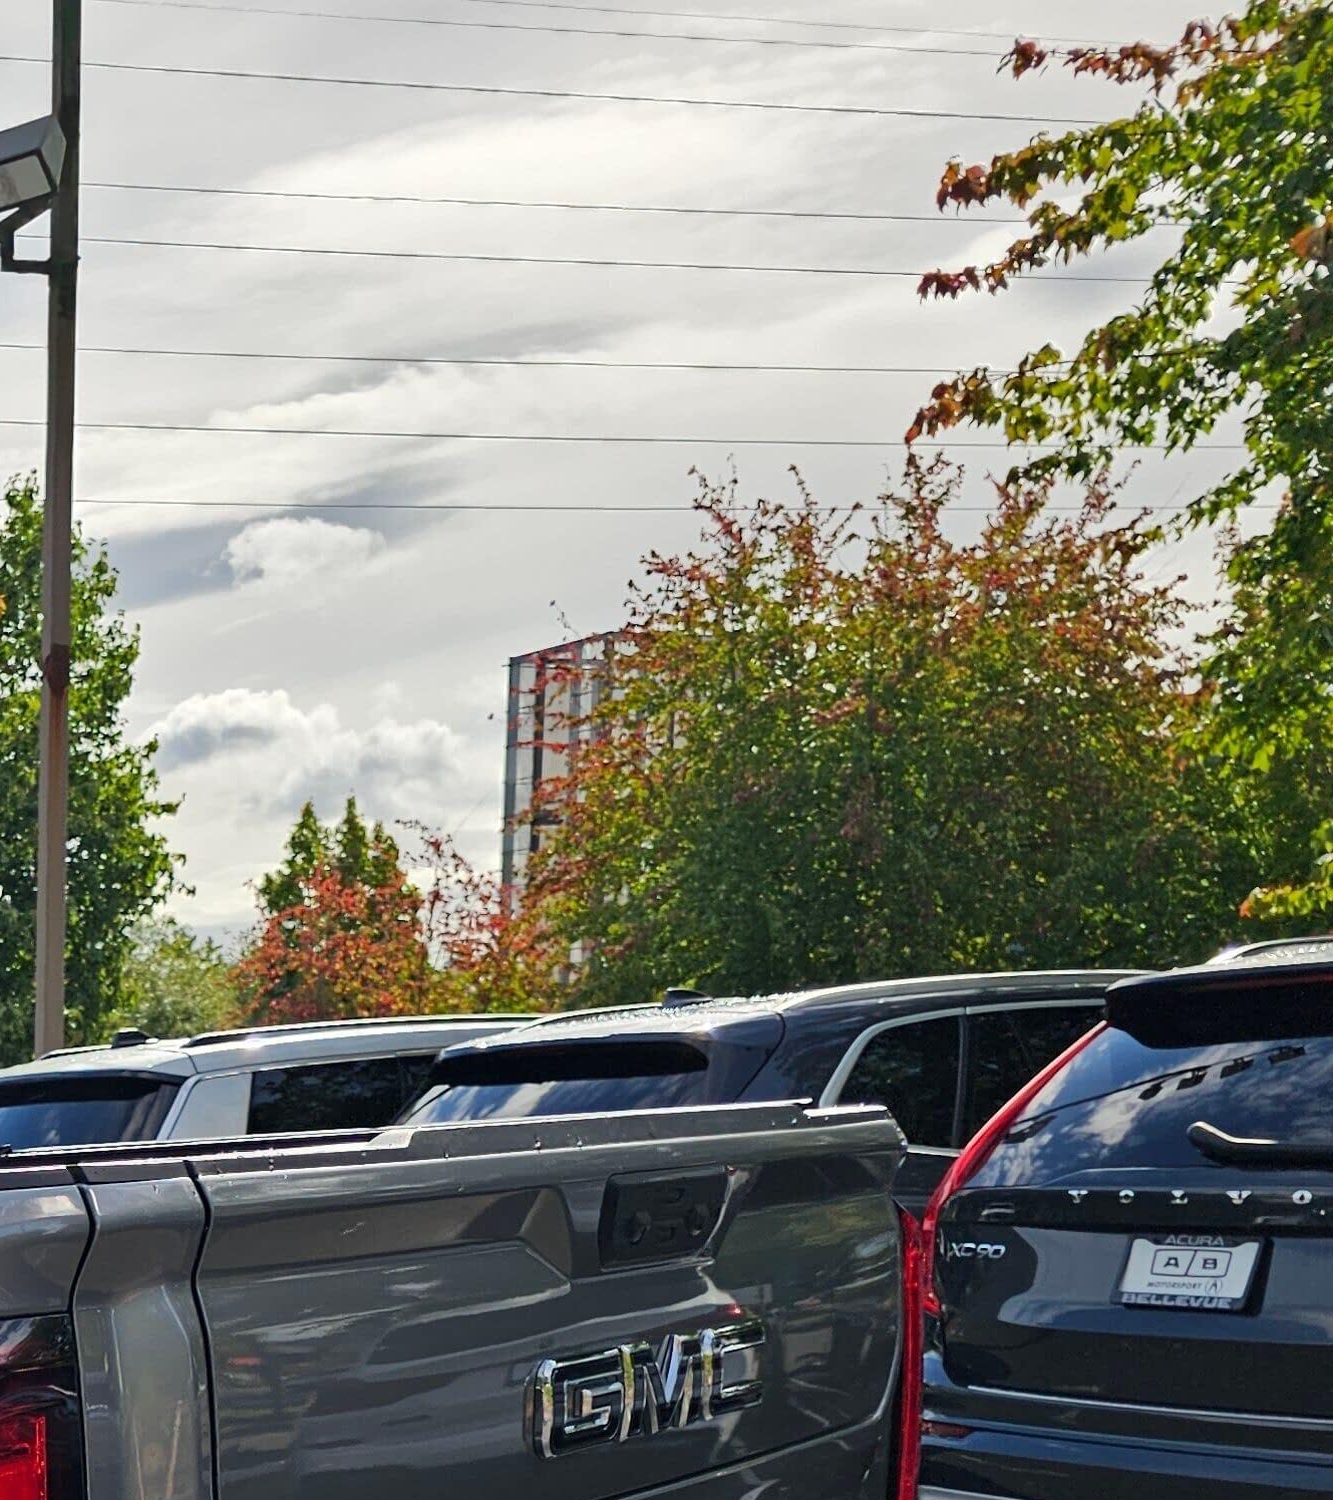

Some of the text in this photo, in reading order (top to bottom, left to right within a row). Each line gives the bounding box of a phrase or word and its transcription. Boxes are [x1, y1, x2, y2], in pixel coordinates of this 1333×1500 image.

[1067, 1189, 1313, 1205] VOLVO
[1164, 1234, 1224, 1247] ACURA
[947, 1242, 1007, 1260] XC90
[1163, 1256, 1219, 1270] A B
[1146, 1280, 1203, 1290] MOTORSPORT
[1121, 1292, 1233, 1309] BELLEVUE
[524, 1319, 766, 1460] GMC
